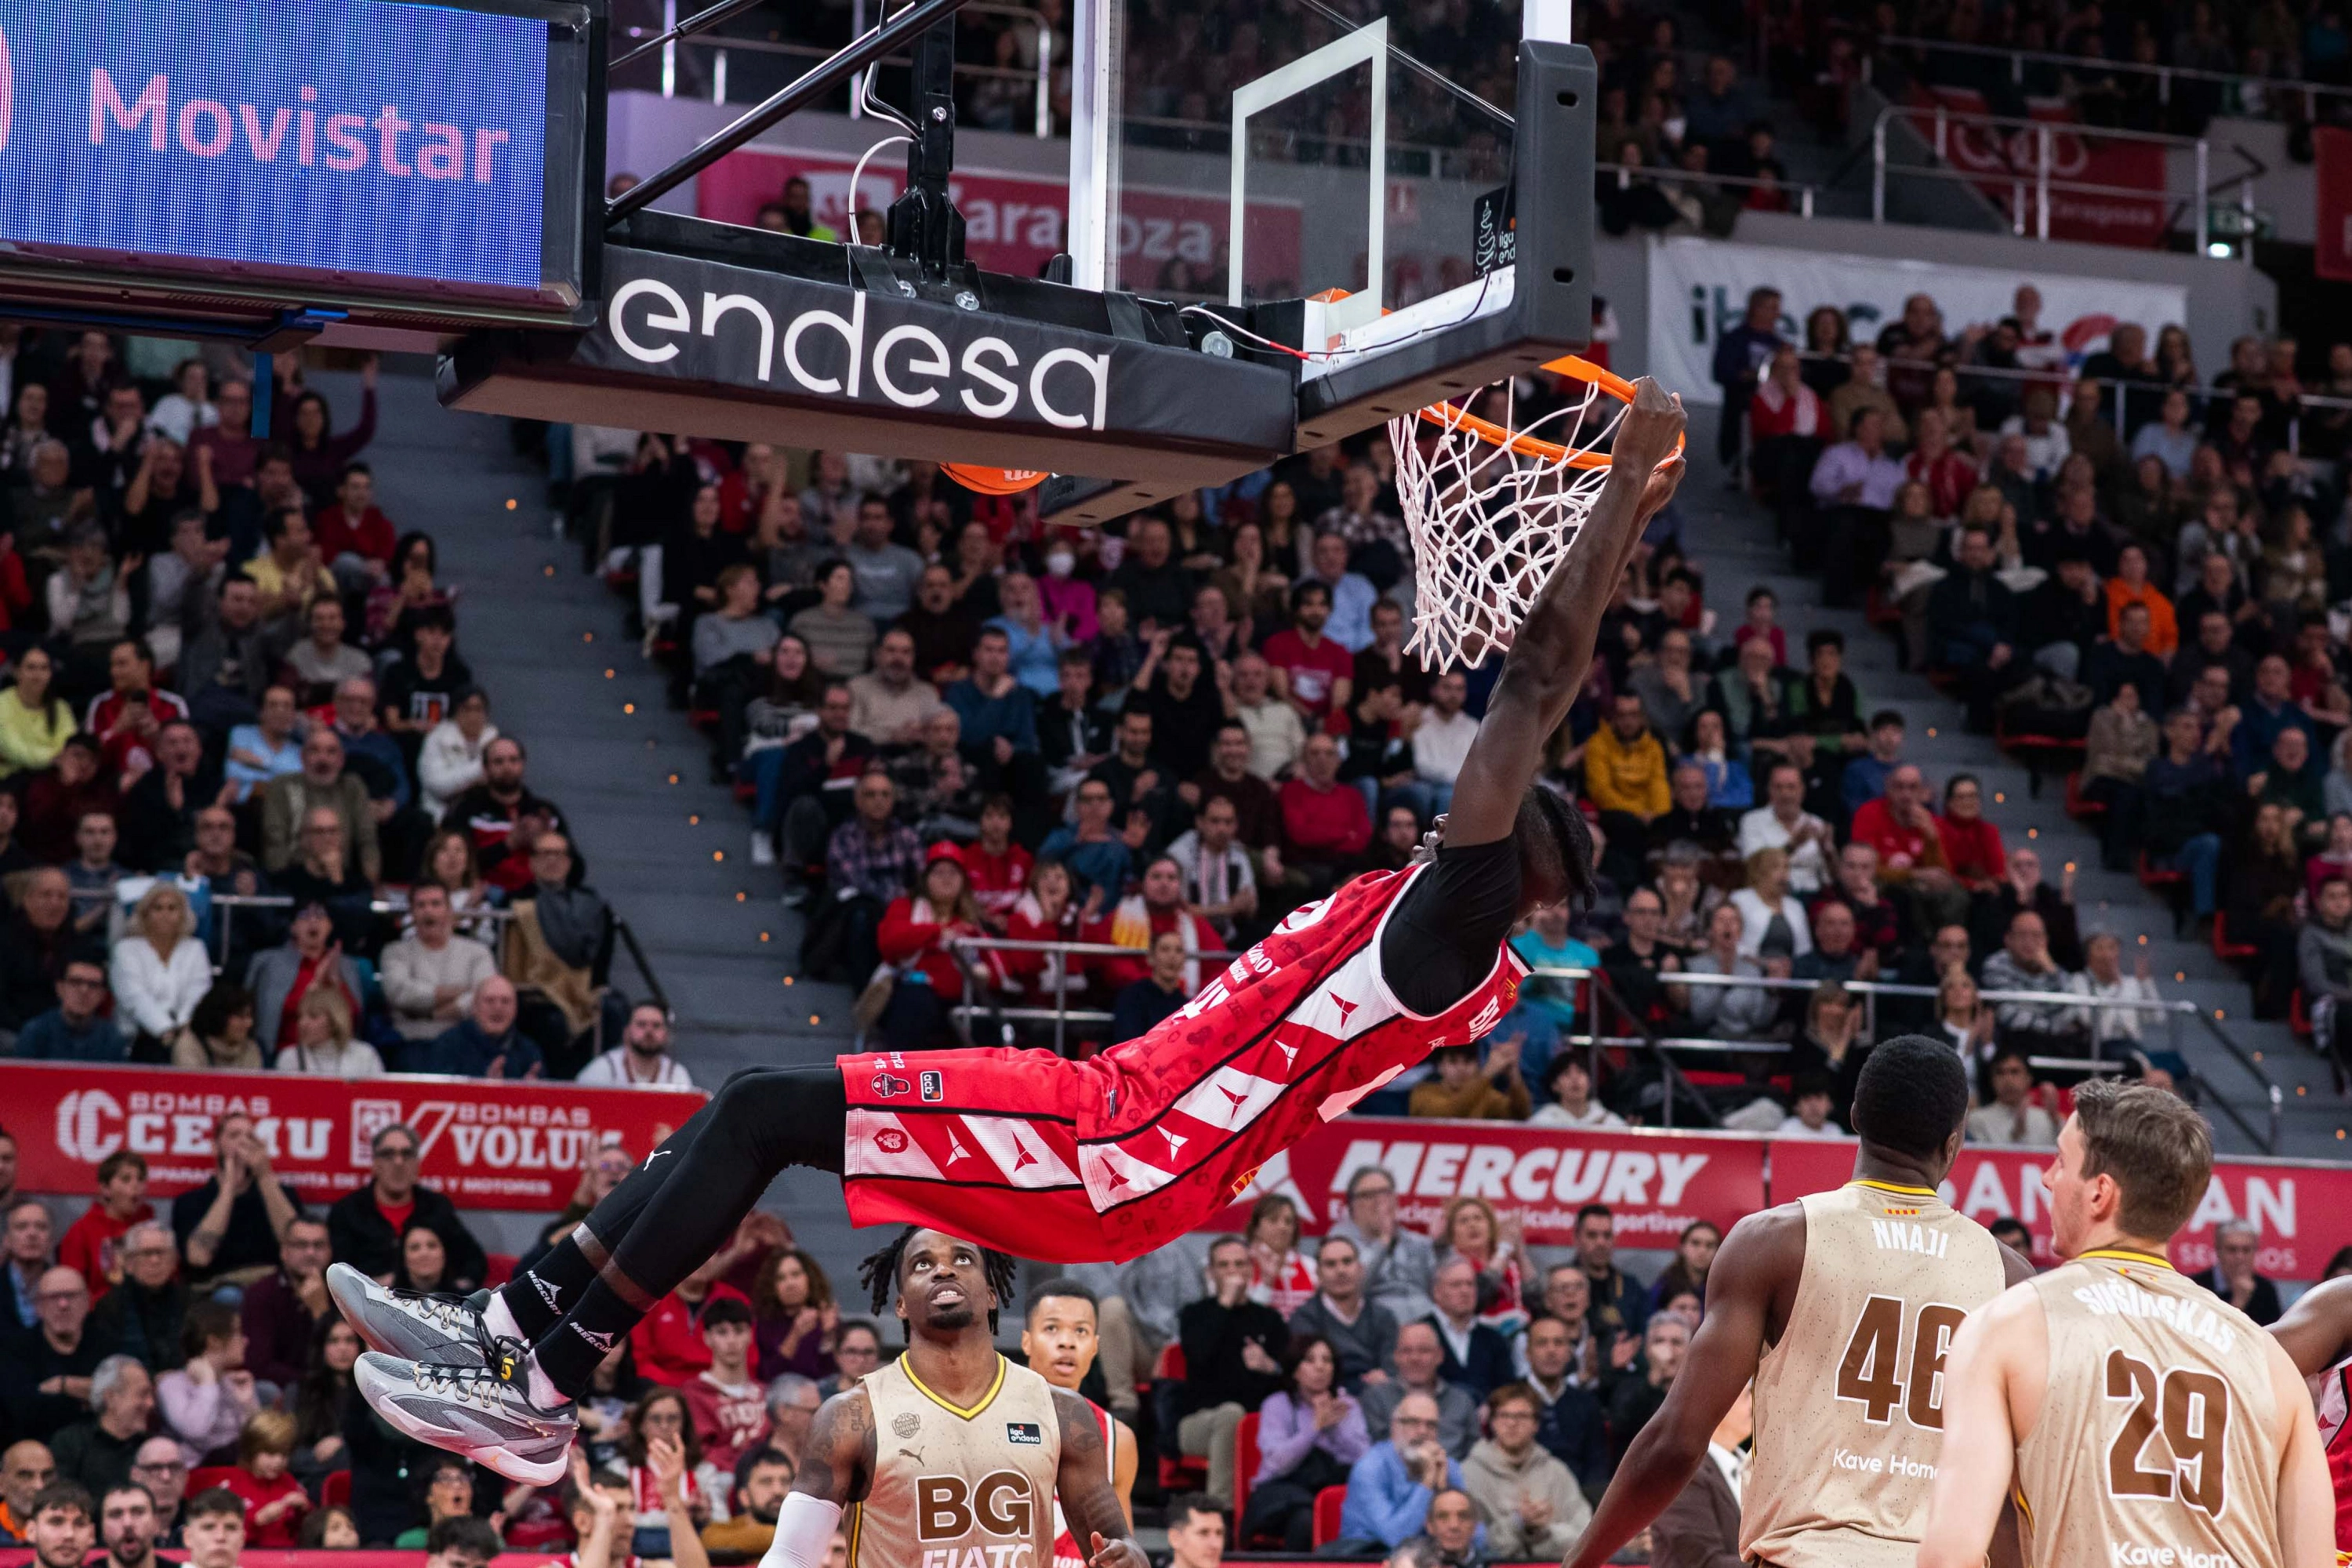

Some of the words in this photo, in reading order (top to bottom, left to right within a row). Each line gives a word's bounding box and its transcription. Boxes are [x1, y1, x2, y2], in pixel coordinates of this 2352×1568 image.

[89, 67, 510, 183] Movistar
[608, 278, 1109, 432] endesa
[128, 1091, 270, 1116] BOMBAS
[923, 1074, 935, 1094] acb
[456, 1102, 590, 1127] BOMBAS
[1330, 1139, 1708, 1206] MERCURY
[1871, 1219, 1949, 1259] NNAJI
[527, 1270, 563, 1316] MERCURY
[1834, 1293, 1970, 1433] 46
[1009, 1428, 1024, 1436] liga
[2104, 1345, 2233, 1523] 29
[1832, 1448, 1883, 1473] Kave
[1889, 1454, 1940, 1480] Hom
[915, 1468, 1033, 1543] BG
[2111, 1541, 2176, 1566] Kave
